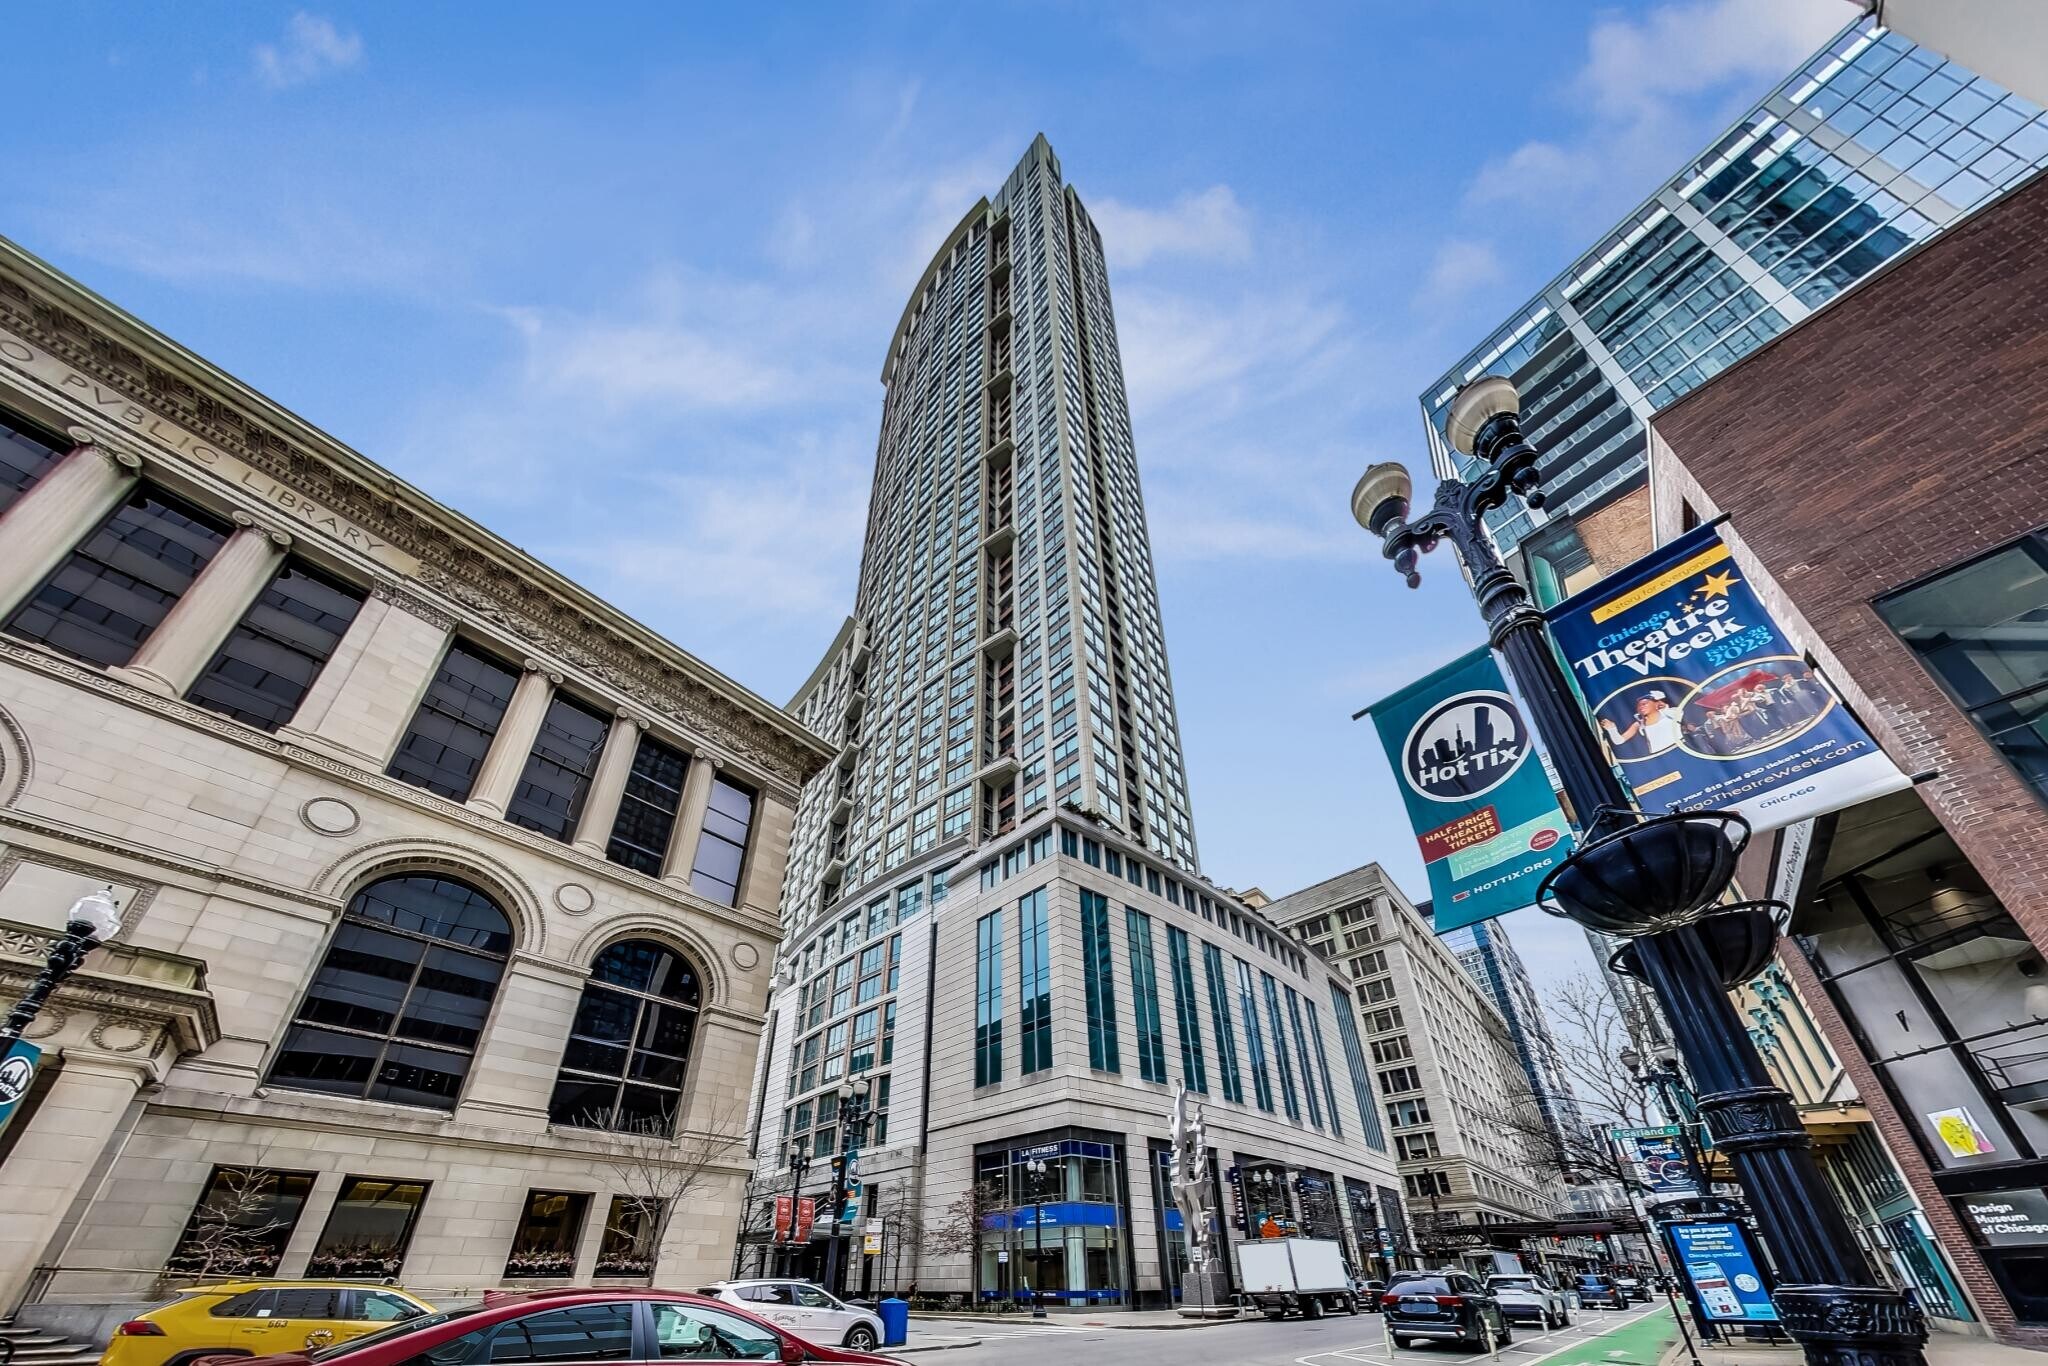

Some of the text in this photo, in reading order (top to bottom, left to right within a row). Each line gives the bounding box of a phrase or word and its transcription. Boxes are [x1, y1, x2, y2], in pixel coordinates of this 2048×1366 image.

[241, 470, 385, 551] LIBRARY
[1615, 594, 1641, 610] story
[1642, 584, 1658, 597] for
[1574, 599, 1730, 678] Theatre
[1597, 610, 1671, 649] Chicago
[1623, 616, 1747, 676] Week
[1705, 640, 1728, 657] Feb
[1708, 631, 1774, 667] 2023
[1418, 745, 1519, 787] Hot Tix
[1677, 740, 1867, 814] agoTheatreWeek.com
[1683, 790, 1703, 804] your
[1724, 776, 1743, 787] and
[1744, 767, 1765, 779] $30
[1765, 752, 1801, 770] tickets
[1760, 785, 1816, 809] CHICAGO
[1425, 810, 1492, 843] HALF-PRICE
[1443, 818, 1494, 844] THEATRE
[1449, 827, 1497, 850] TICKETS
[1473, 857, 1553, 894] HOTTIX.ORG
[1622, 1128, 1665, 1137] Garland
[1032, 1144, 1058, 1154] FITNESS
[1967, 1203, 2014, 1214] Design
[1974, 1214, 2030, 1224] Museum
[1981, 1223, 2048, 1235] of Chicago
[268, 1320, 288, 1328] 663
